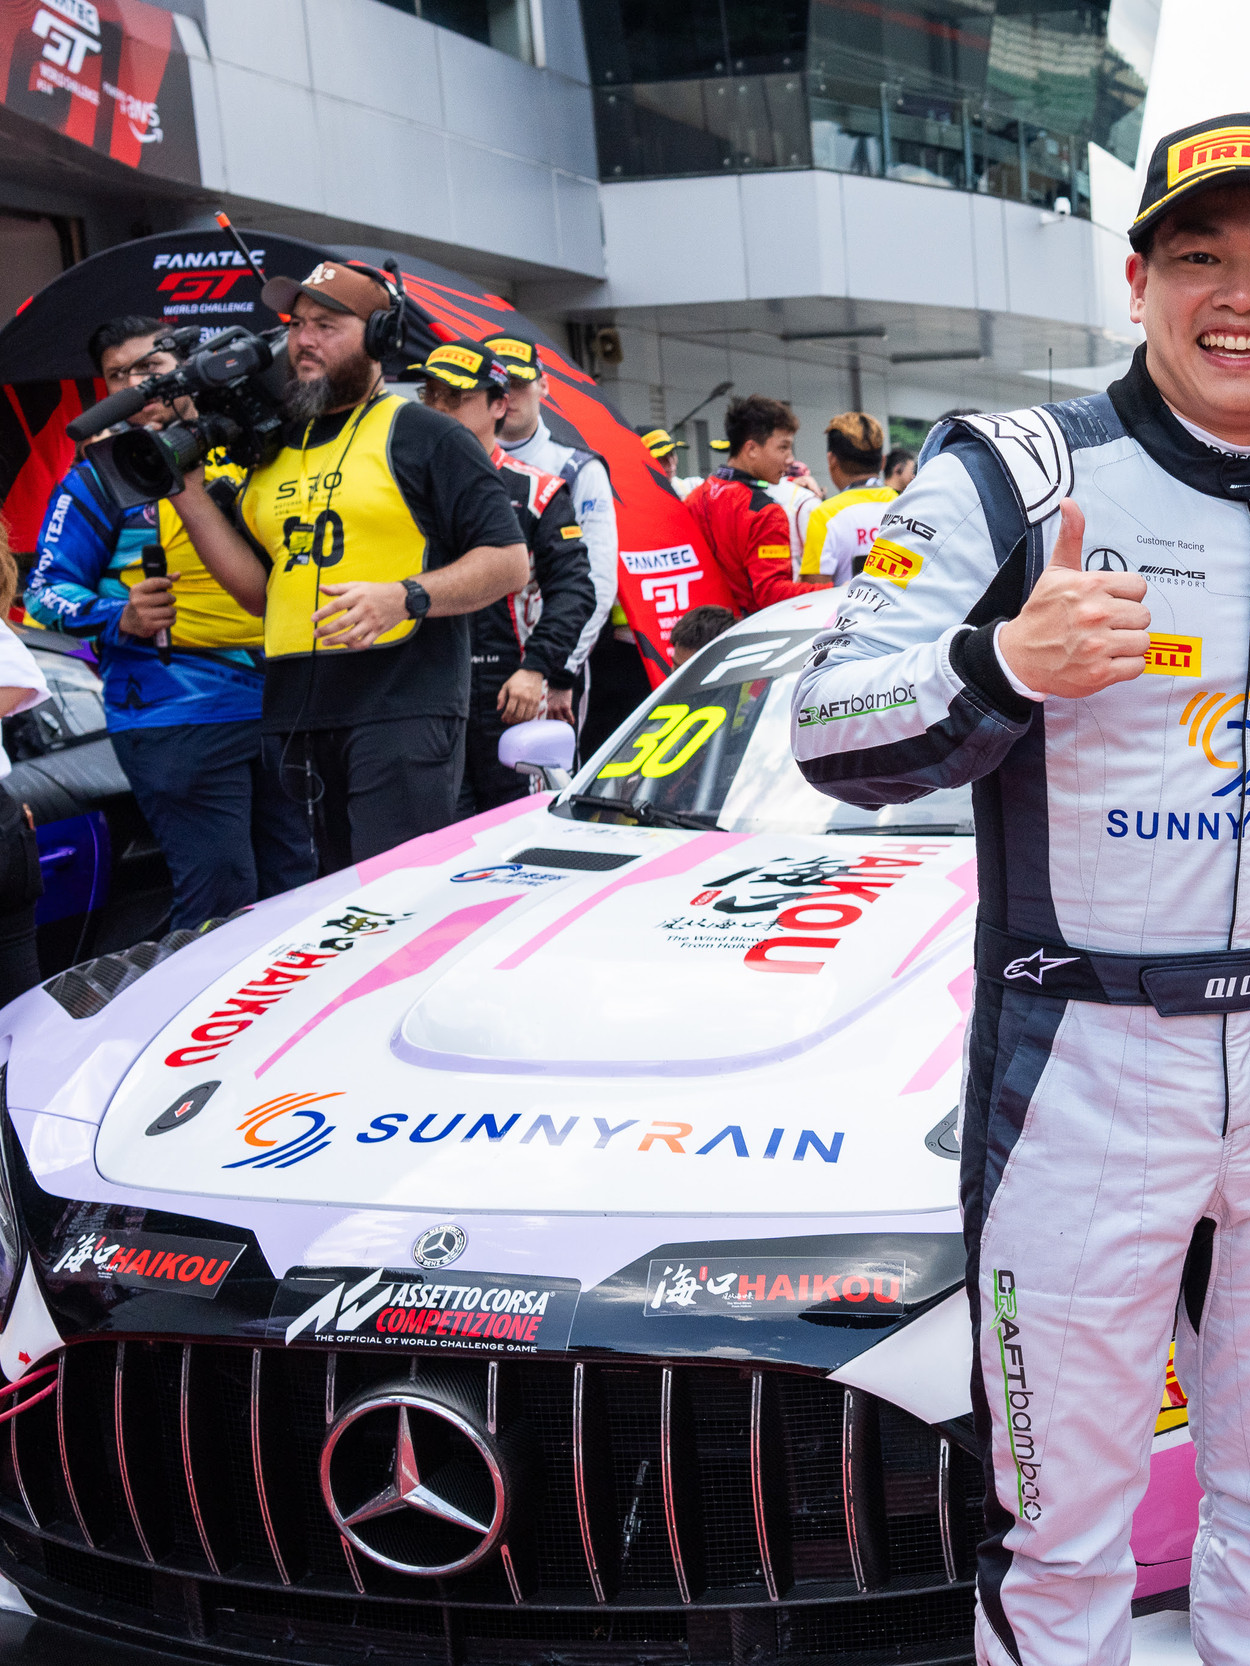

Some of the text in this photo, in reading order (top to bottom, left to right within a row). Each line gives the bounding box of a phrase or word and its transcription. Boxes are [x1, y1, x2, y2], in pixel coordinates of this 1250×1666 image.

[153, 250, 265, 270] FANATEC
[157, 269, 265, 302] GT
[163, 301, 255, 316] WORLD CHALLENGE
[45, 494, 73, 543] TEAM
[888, 515, 937, 541] AMG
[626, 549, 692, 570] FANATEC
[1136, 535, 1205, 552] Customer Racing
[1159, 568, 1206, 579] AMG
[641, 571, 704, 613] GT
[598, 704, 727, 779] 30
[744, 843, 953, 975] HAIKOU
[1204, 976, 1237, 999] QI
[164, 950, 340, 1068] HAIKOU
[356, 1113, 846, 1163] SUNNYRAIN
[106, 1246, 231, 1286] HAIKOU
[390, 1284, 550, 1316] ASSETTO CORSA
[651, 1263, 738, 1309] 海口
[738, 1274, 901, 1303] HAIKOU
[376, 1307, 543, 1342] COMPETIZIONE
[315, 1334, 538, 1353] THE OFFICIAL GT WORLD CHALLENGE GAME
[989, 1269, 1042, 1522] CRAFTbamboo
